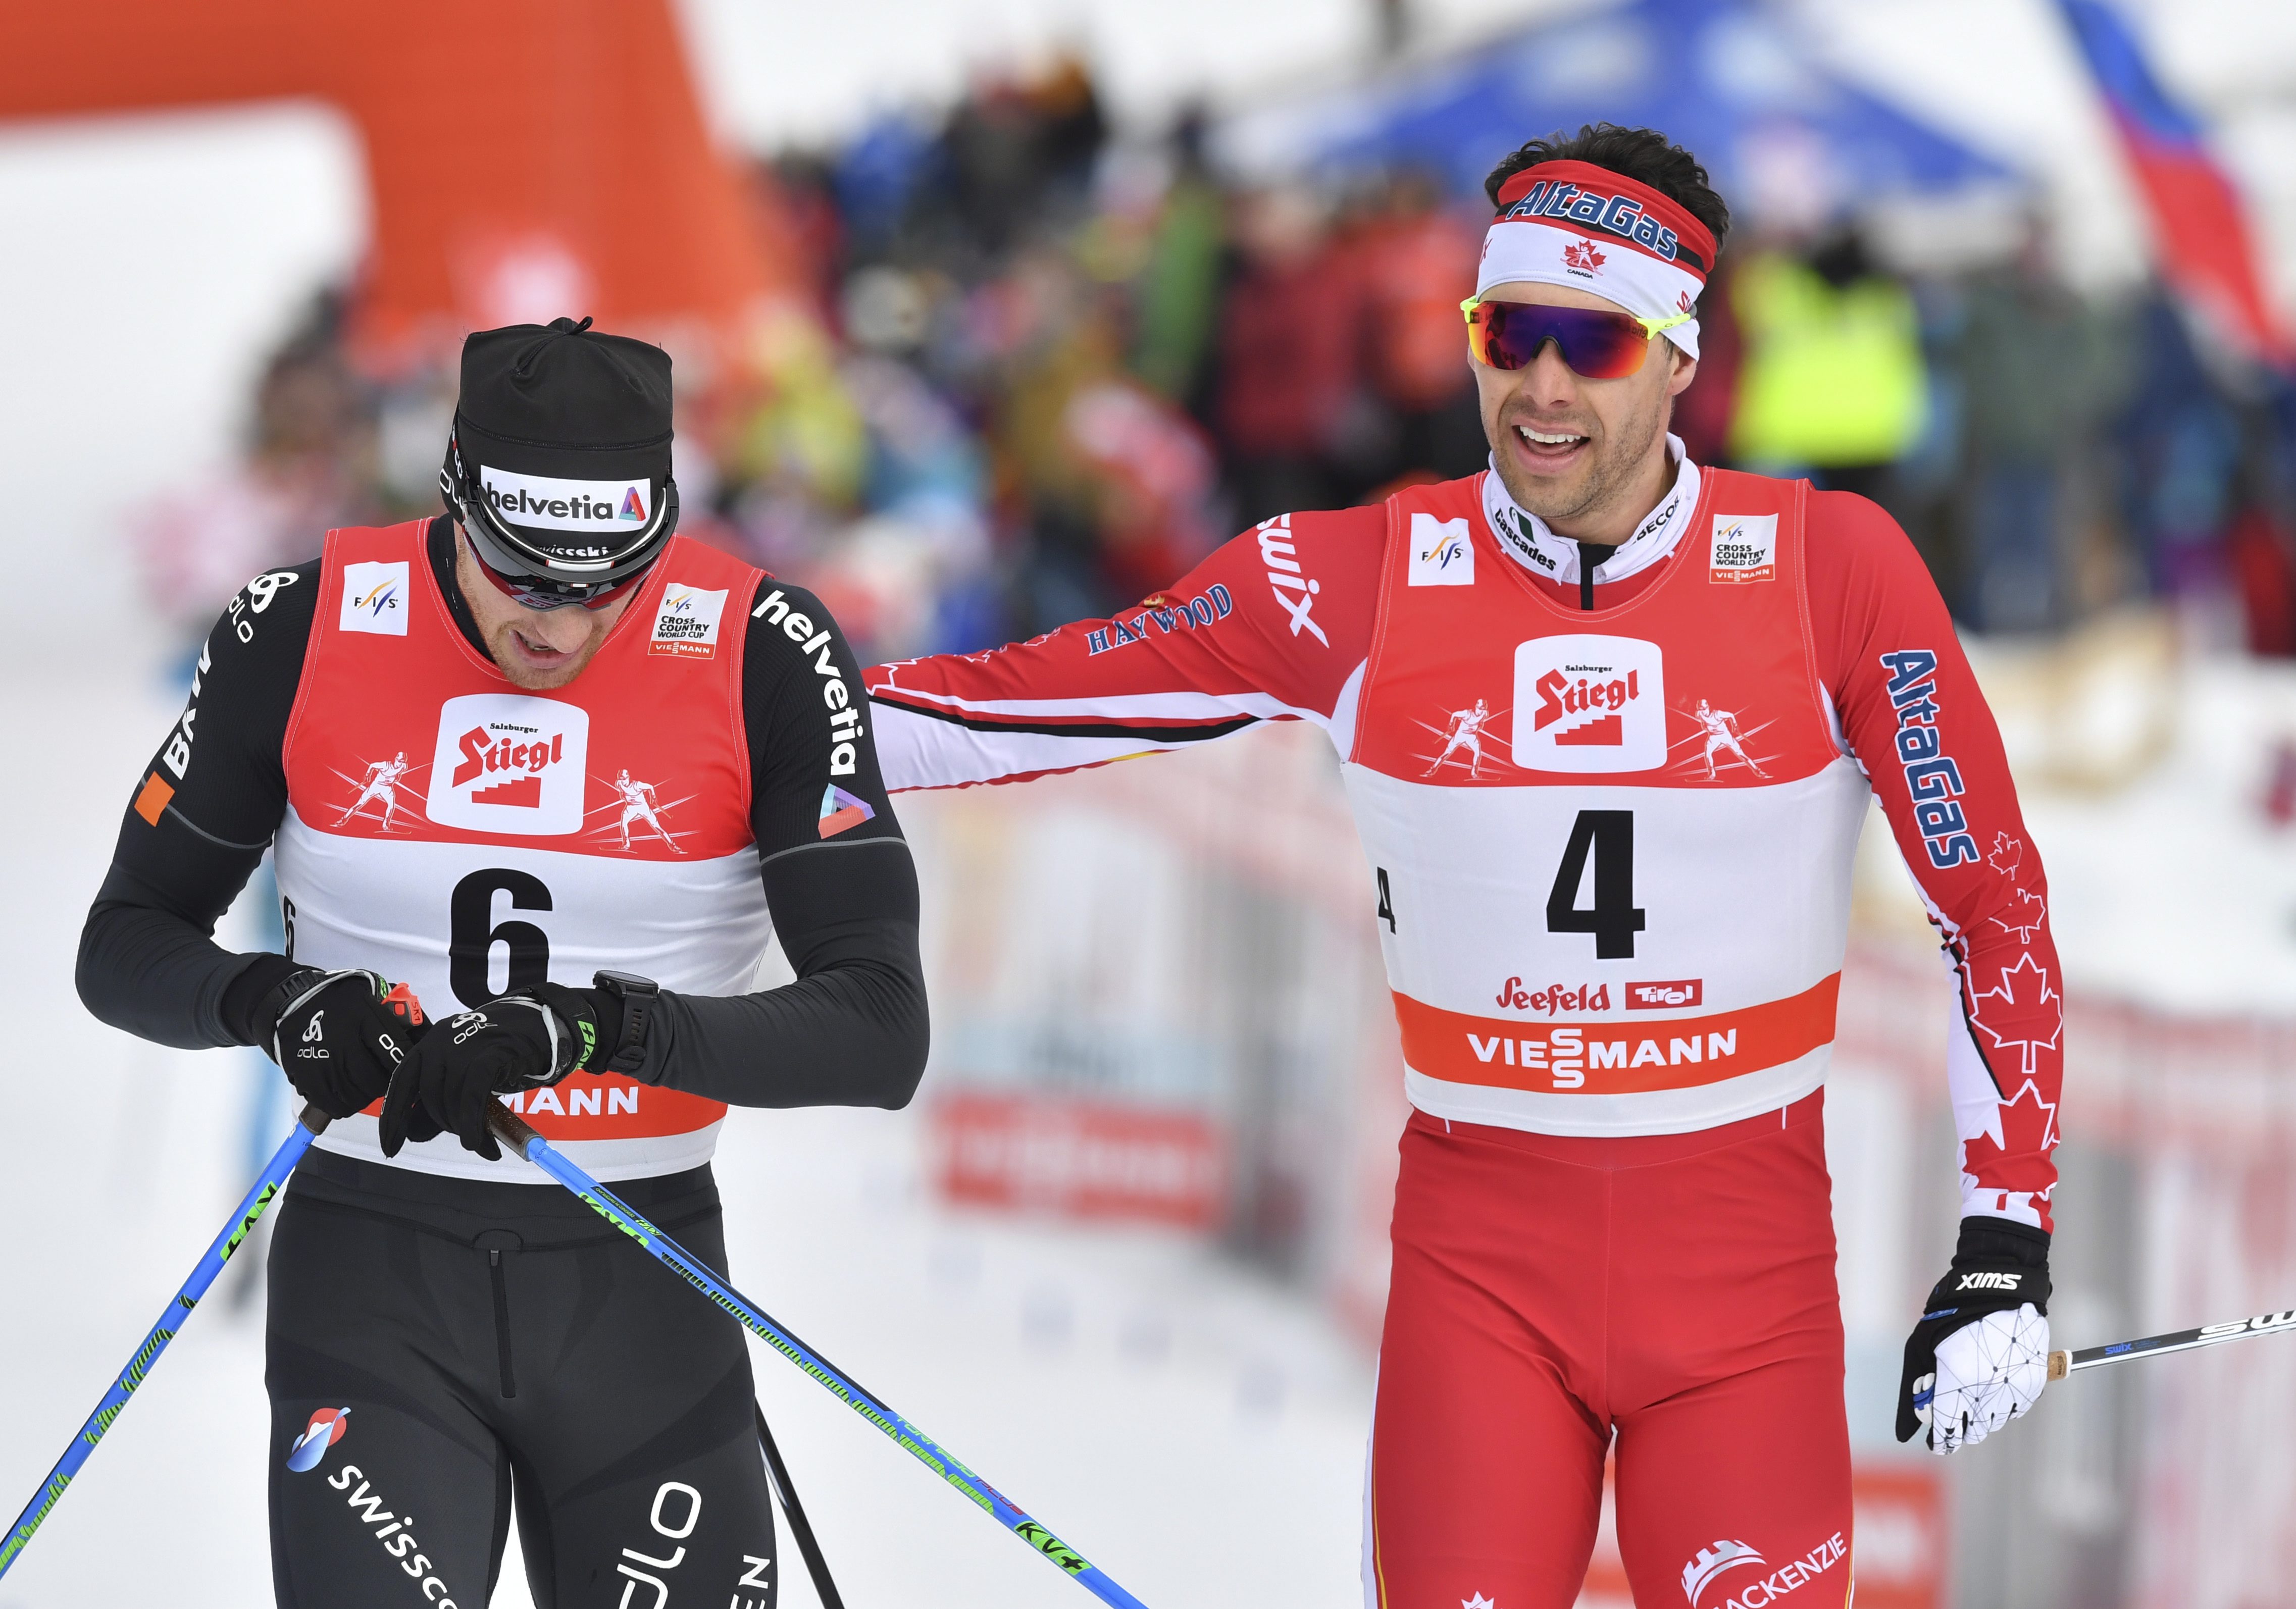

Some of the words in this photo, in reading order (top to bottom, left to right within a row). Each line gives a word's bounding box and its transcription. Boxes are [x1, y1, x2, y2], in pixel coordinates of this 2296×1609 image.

[1505, 180, 1677, 262] AltaGas
[1567, 269, 1593, 279] CANADA
[487, 481, 613, 520] helvetia
[1495, 507, 1556, 571] Cascades
[1716, 548, 1766, 559] COUNTRY
[1748, 557, 1762, 565] CUP
[1715, 568, 1769, 582] VIESSMANN
[659, 624, 710, 632] COUNTRY
[661, 615, 696, 625] CROSS
[655, 642, 710, 654] VIESSMANN
[1565, 664, 1613, 673] Salzburger
[751, 590, 863, 775] helvetia
[1535, 668, 1640, 732] Stiegl
[490, 722, 539, 734] Salzburger
[452, 725, 563, 788] Stiegl
[1879, 650, 1980, 869] AltaGas
[1377, 867, 1396, 935] 4
[1546, 810, 1646, 959] 4
[283, 895, 296, 962] 6
[450, 868, 553, 1010] 6
[1496, 976, 1611, 1016] Seefeld
[1635, 985, 1693, 1005] Tirol
[297, 1046, 329, 1059] odlo
[453, 1022, 498, 1045] odlo
[1466, 1028, 1737, 1088] VIESSMANN
[897, 1414, 976, 1478] TORNADO
[976, 1479, 1024, 1516] PLUS
[1014, 1521, 1089, 1573] KV+
[1713, 1531, 1847, 1609] ACKENZIE
